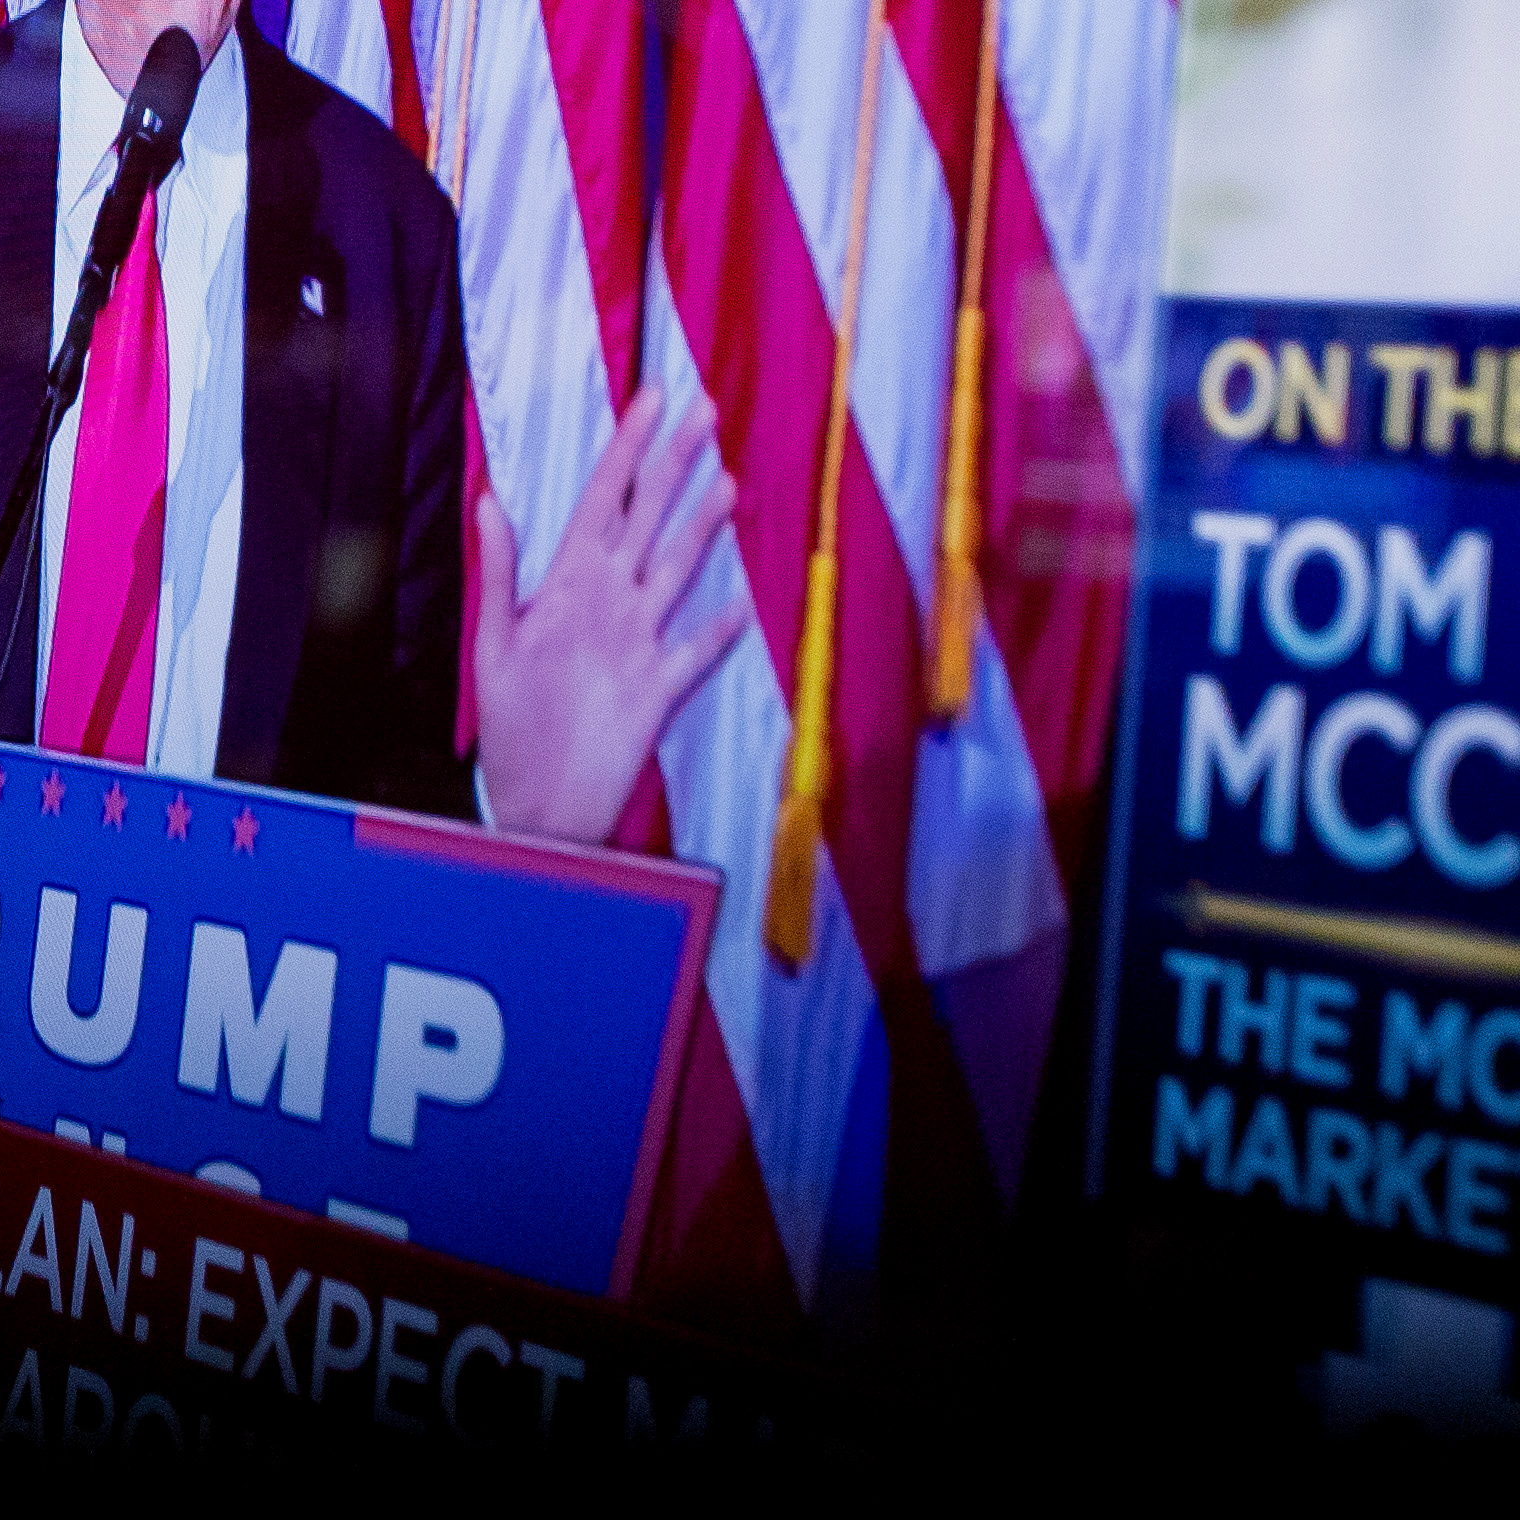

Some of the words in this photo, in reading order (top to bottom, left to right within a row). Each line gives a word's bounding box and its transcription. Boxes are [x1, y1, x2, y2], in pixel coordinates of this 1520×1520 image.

[1198, 337, 1354, 446] ON
[1368, 343, 1520, 462] TH
[1191, 509, 1493, 685] TOM
[1160, 946, 1358, 1089] THE
[1148, 1071, 1520, 1259] MARKE
[182, 1235, 589, 1452] EXPECT
